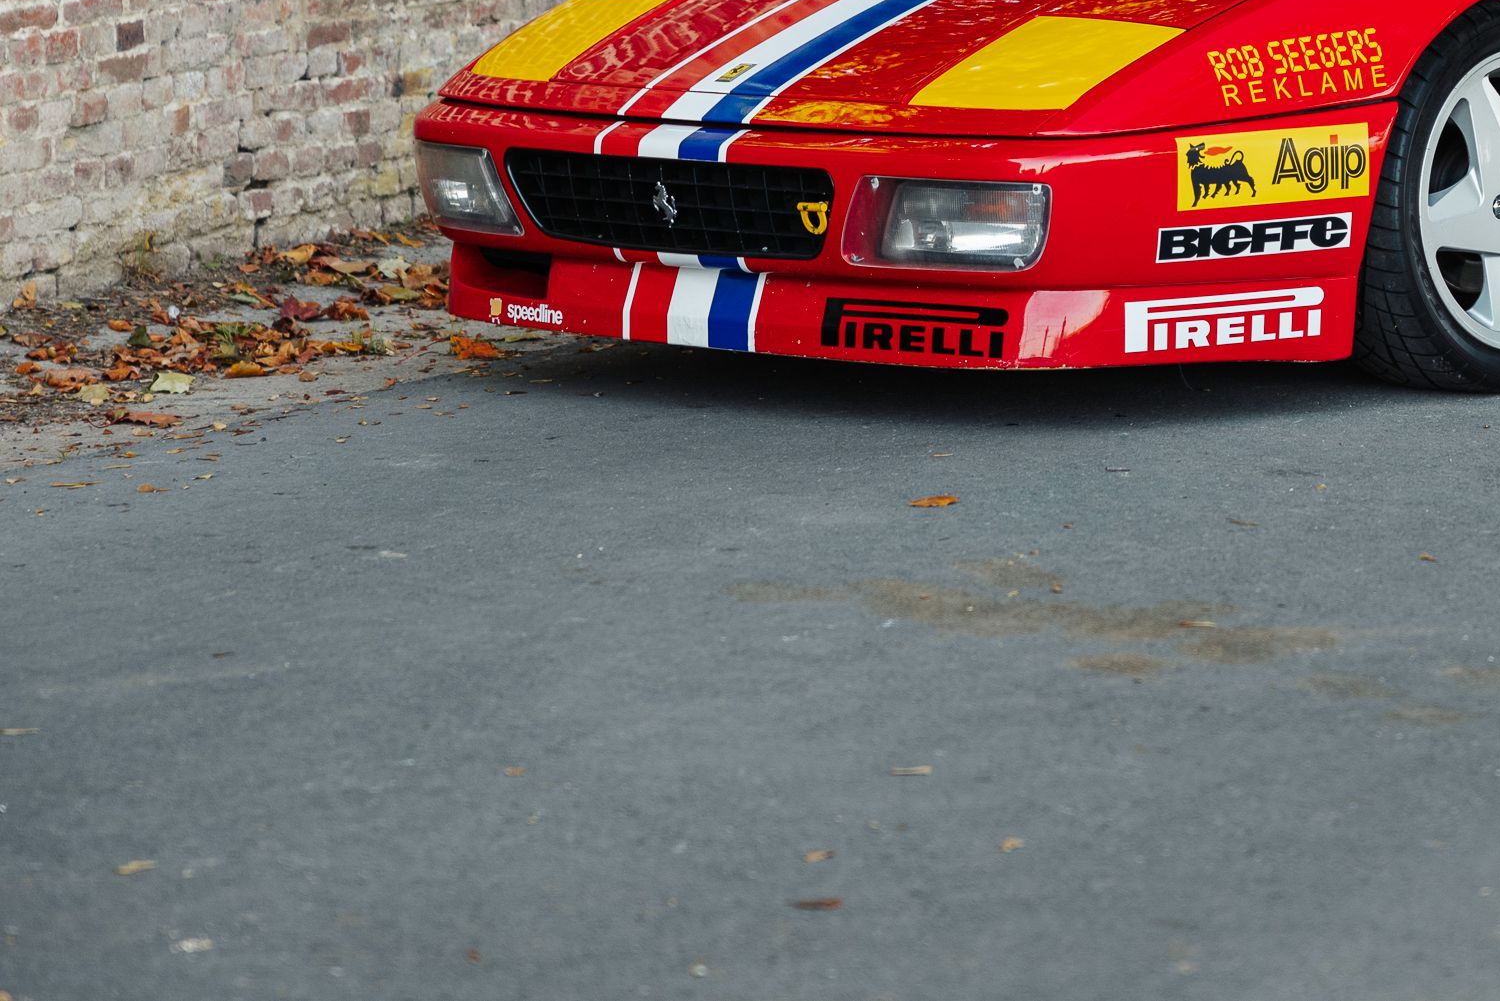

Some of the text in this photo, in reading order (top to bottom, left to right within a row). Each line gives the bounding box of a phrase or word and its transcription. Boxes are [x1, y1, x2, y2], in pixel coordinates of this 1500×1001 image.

[1207, 27, 1383, 83] ROB SEEGERS
[1221, 64, 1388, 107] REKLAME
[1271, 134, 1367, 194] Agip
[507, 303, 563, 325] speedline
[820, 296, 1010, 359] PIRELLI
[1124, 286, 1325, 354] PIRELLI
